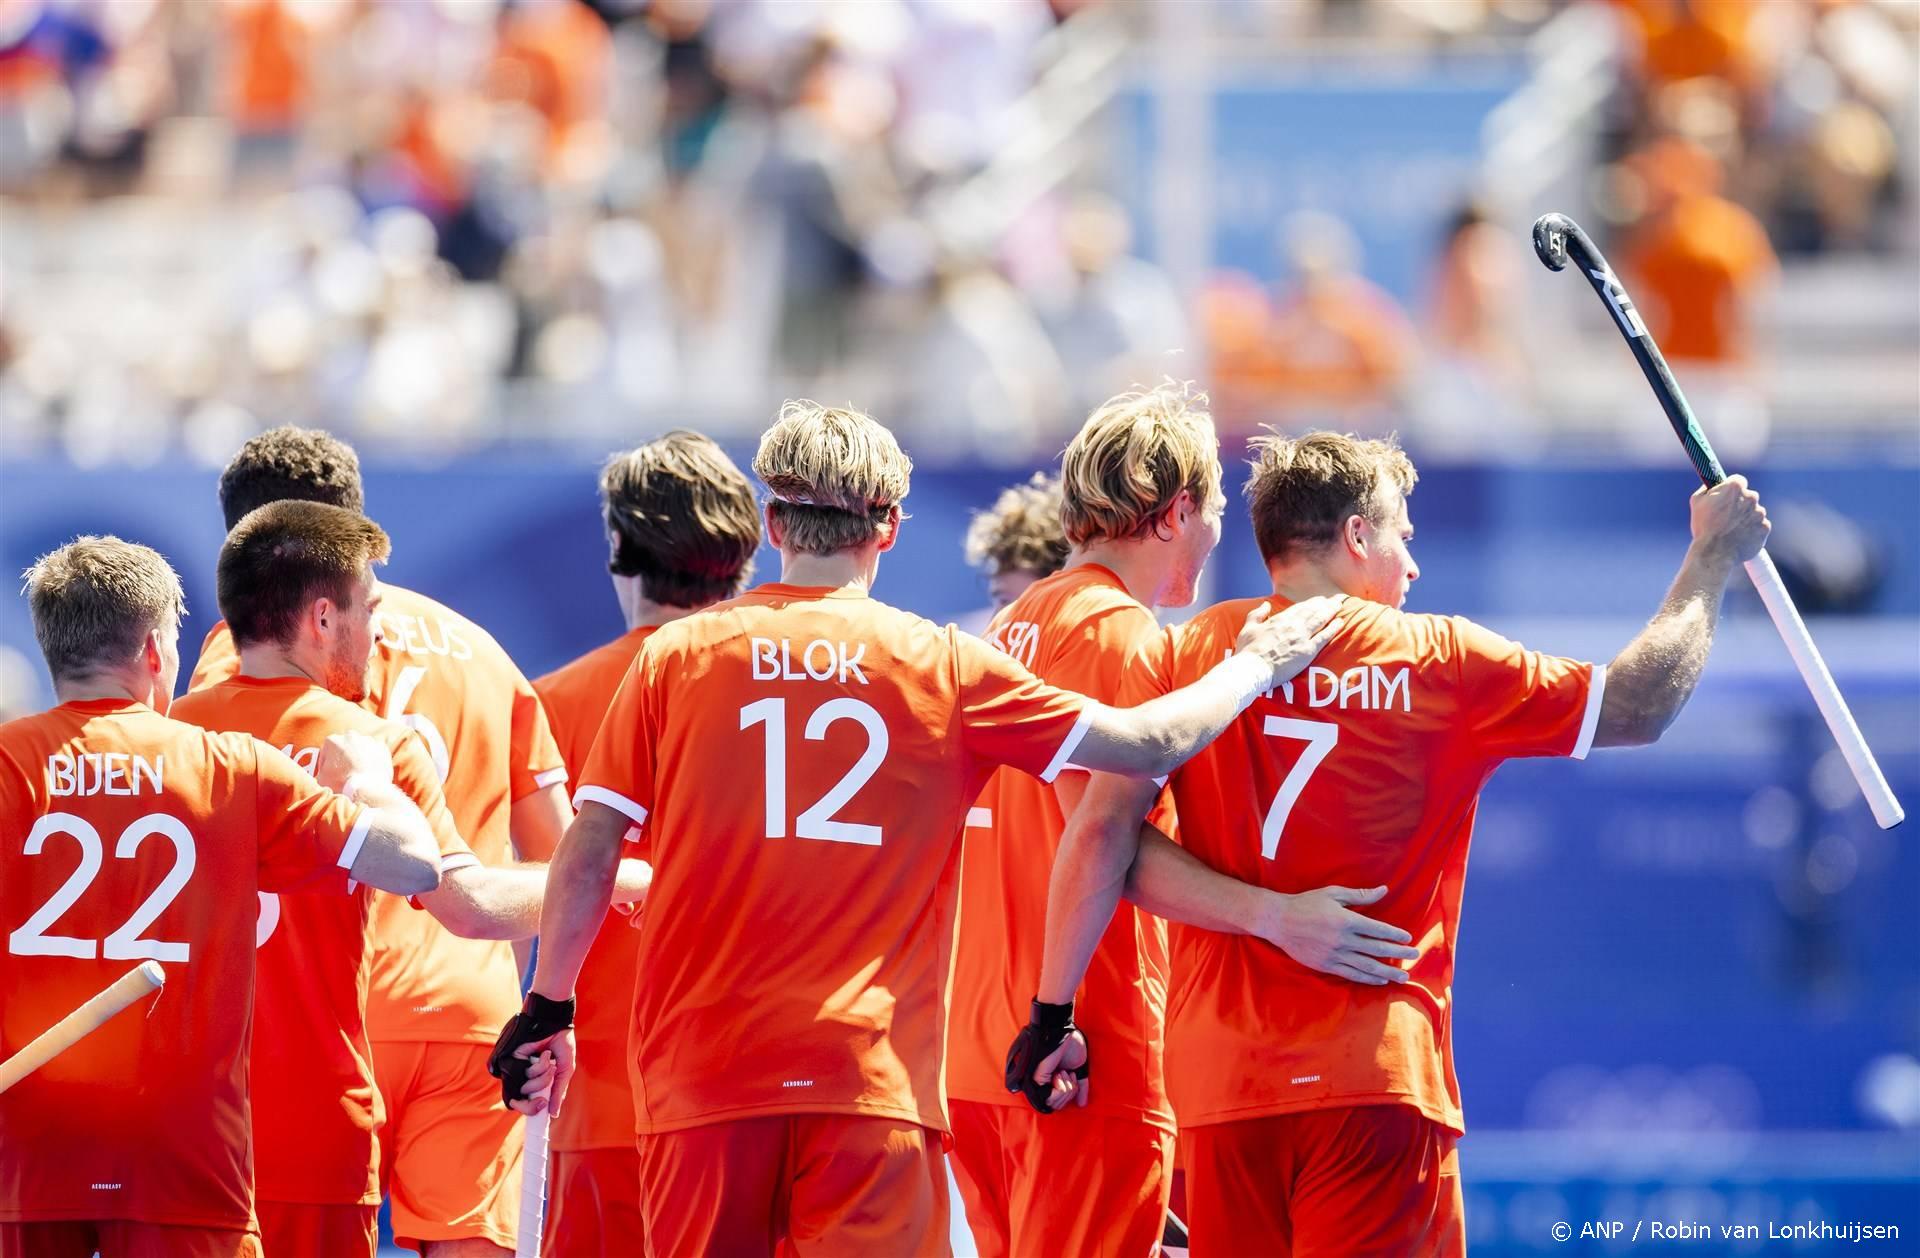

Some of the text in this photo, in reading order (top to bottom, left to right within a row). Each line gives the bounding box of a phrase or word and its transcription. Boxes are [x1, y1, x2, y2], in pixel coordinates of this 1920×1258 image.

[751, 637, 869, 685] BLOK
[1308, 665, 1411, 712] DAM
[48, 752, 164, 796] BIJEN
[740, 697, 889, 846] 12
[1261, 714, 1339, 861] 7
[9, 812, 196, 962] 22
